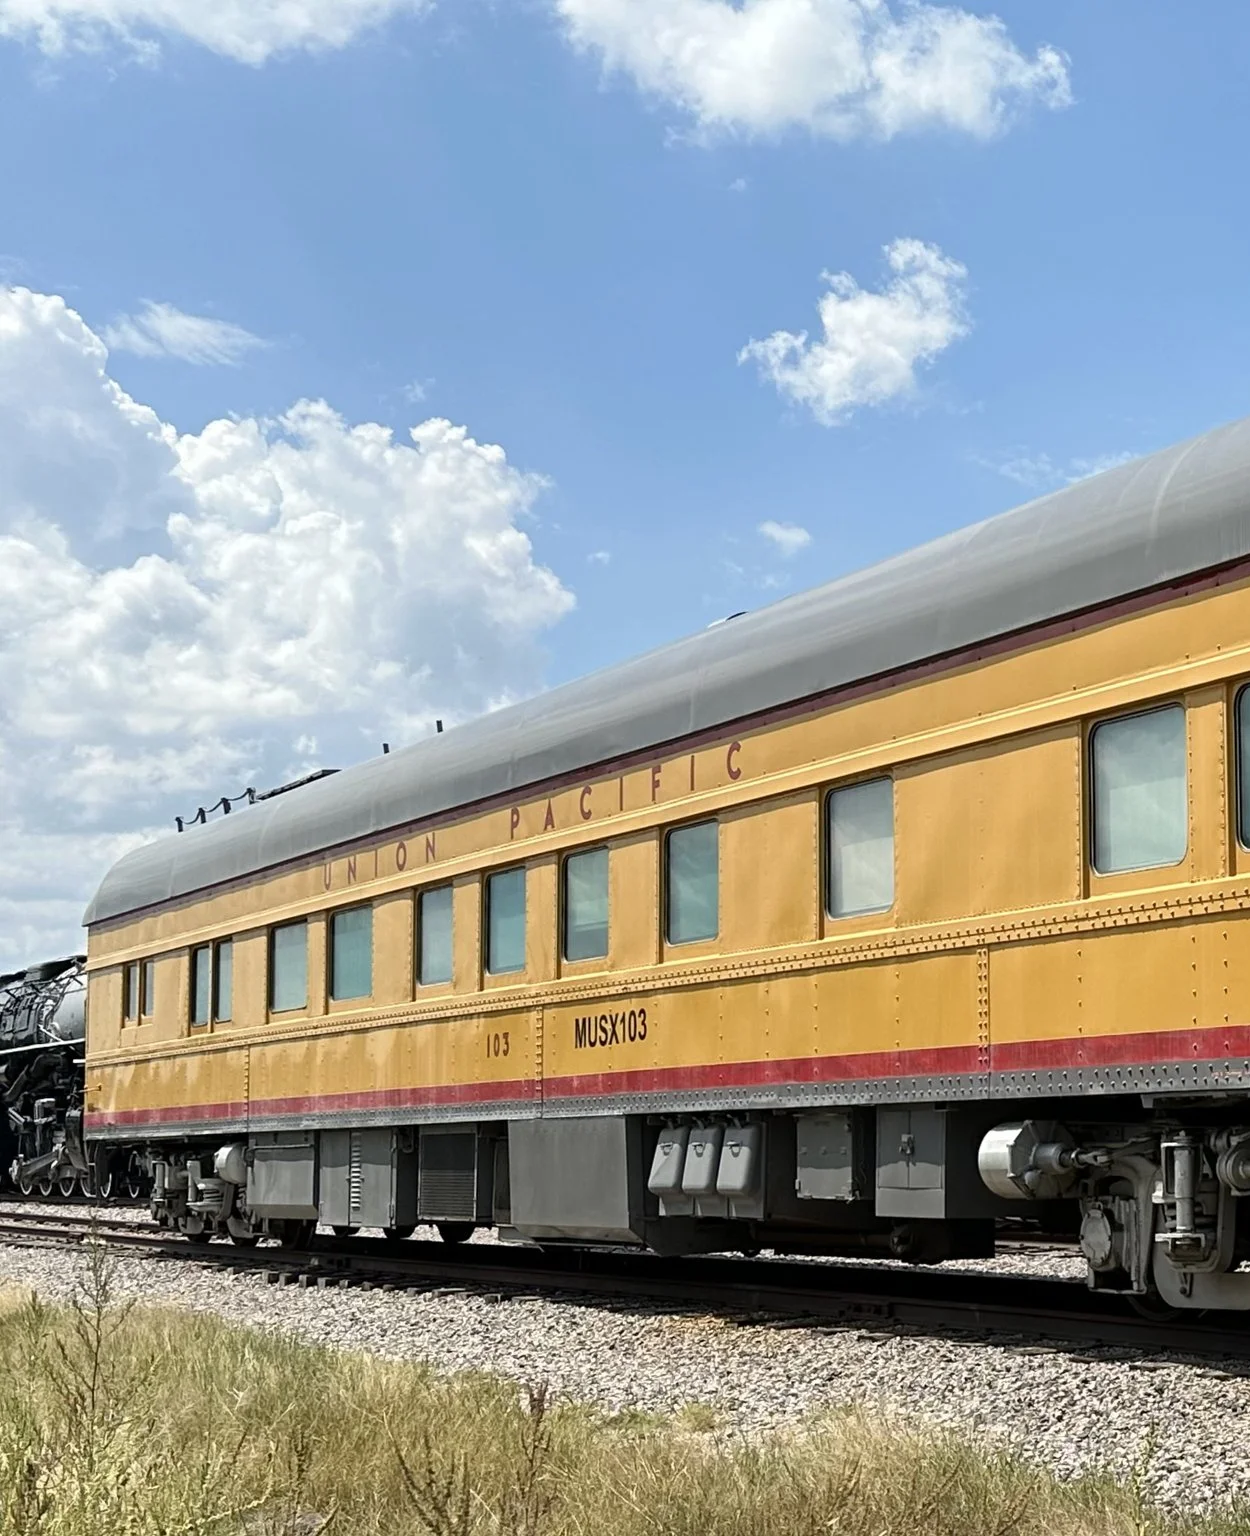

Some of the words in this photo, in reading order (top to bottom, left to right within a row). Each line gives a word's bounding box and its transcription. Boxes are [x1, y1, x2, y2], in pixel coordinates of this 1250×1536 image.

[323, 831, 436, 891] UNION
[510, 741, 742, 841] PACIFIC
[486, 1032, 510, 1059] 103
[574, 1008, 648, 1049] MUSX103
